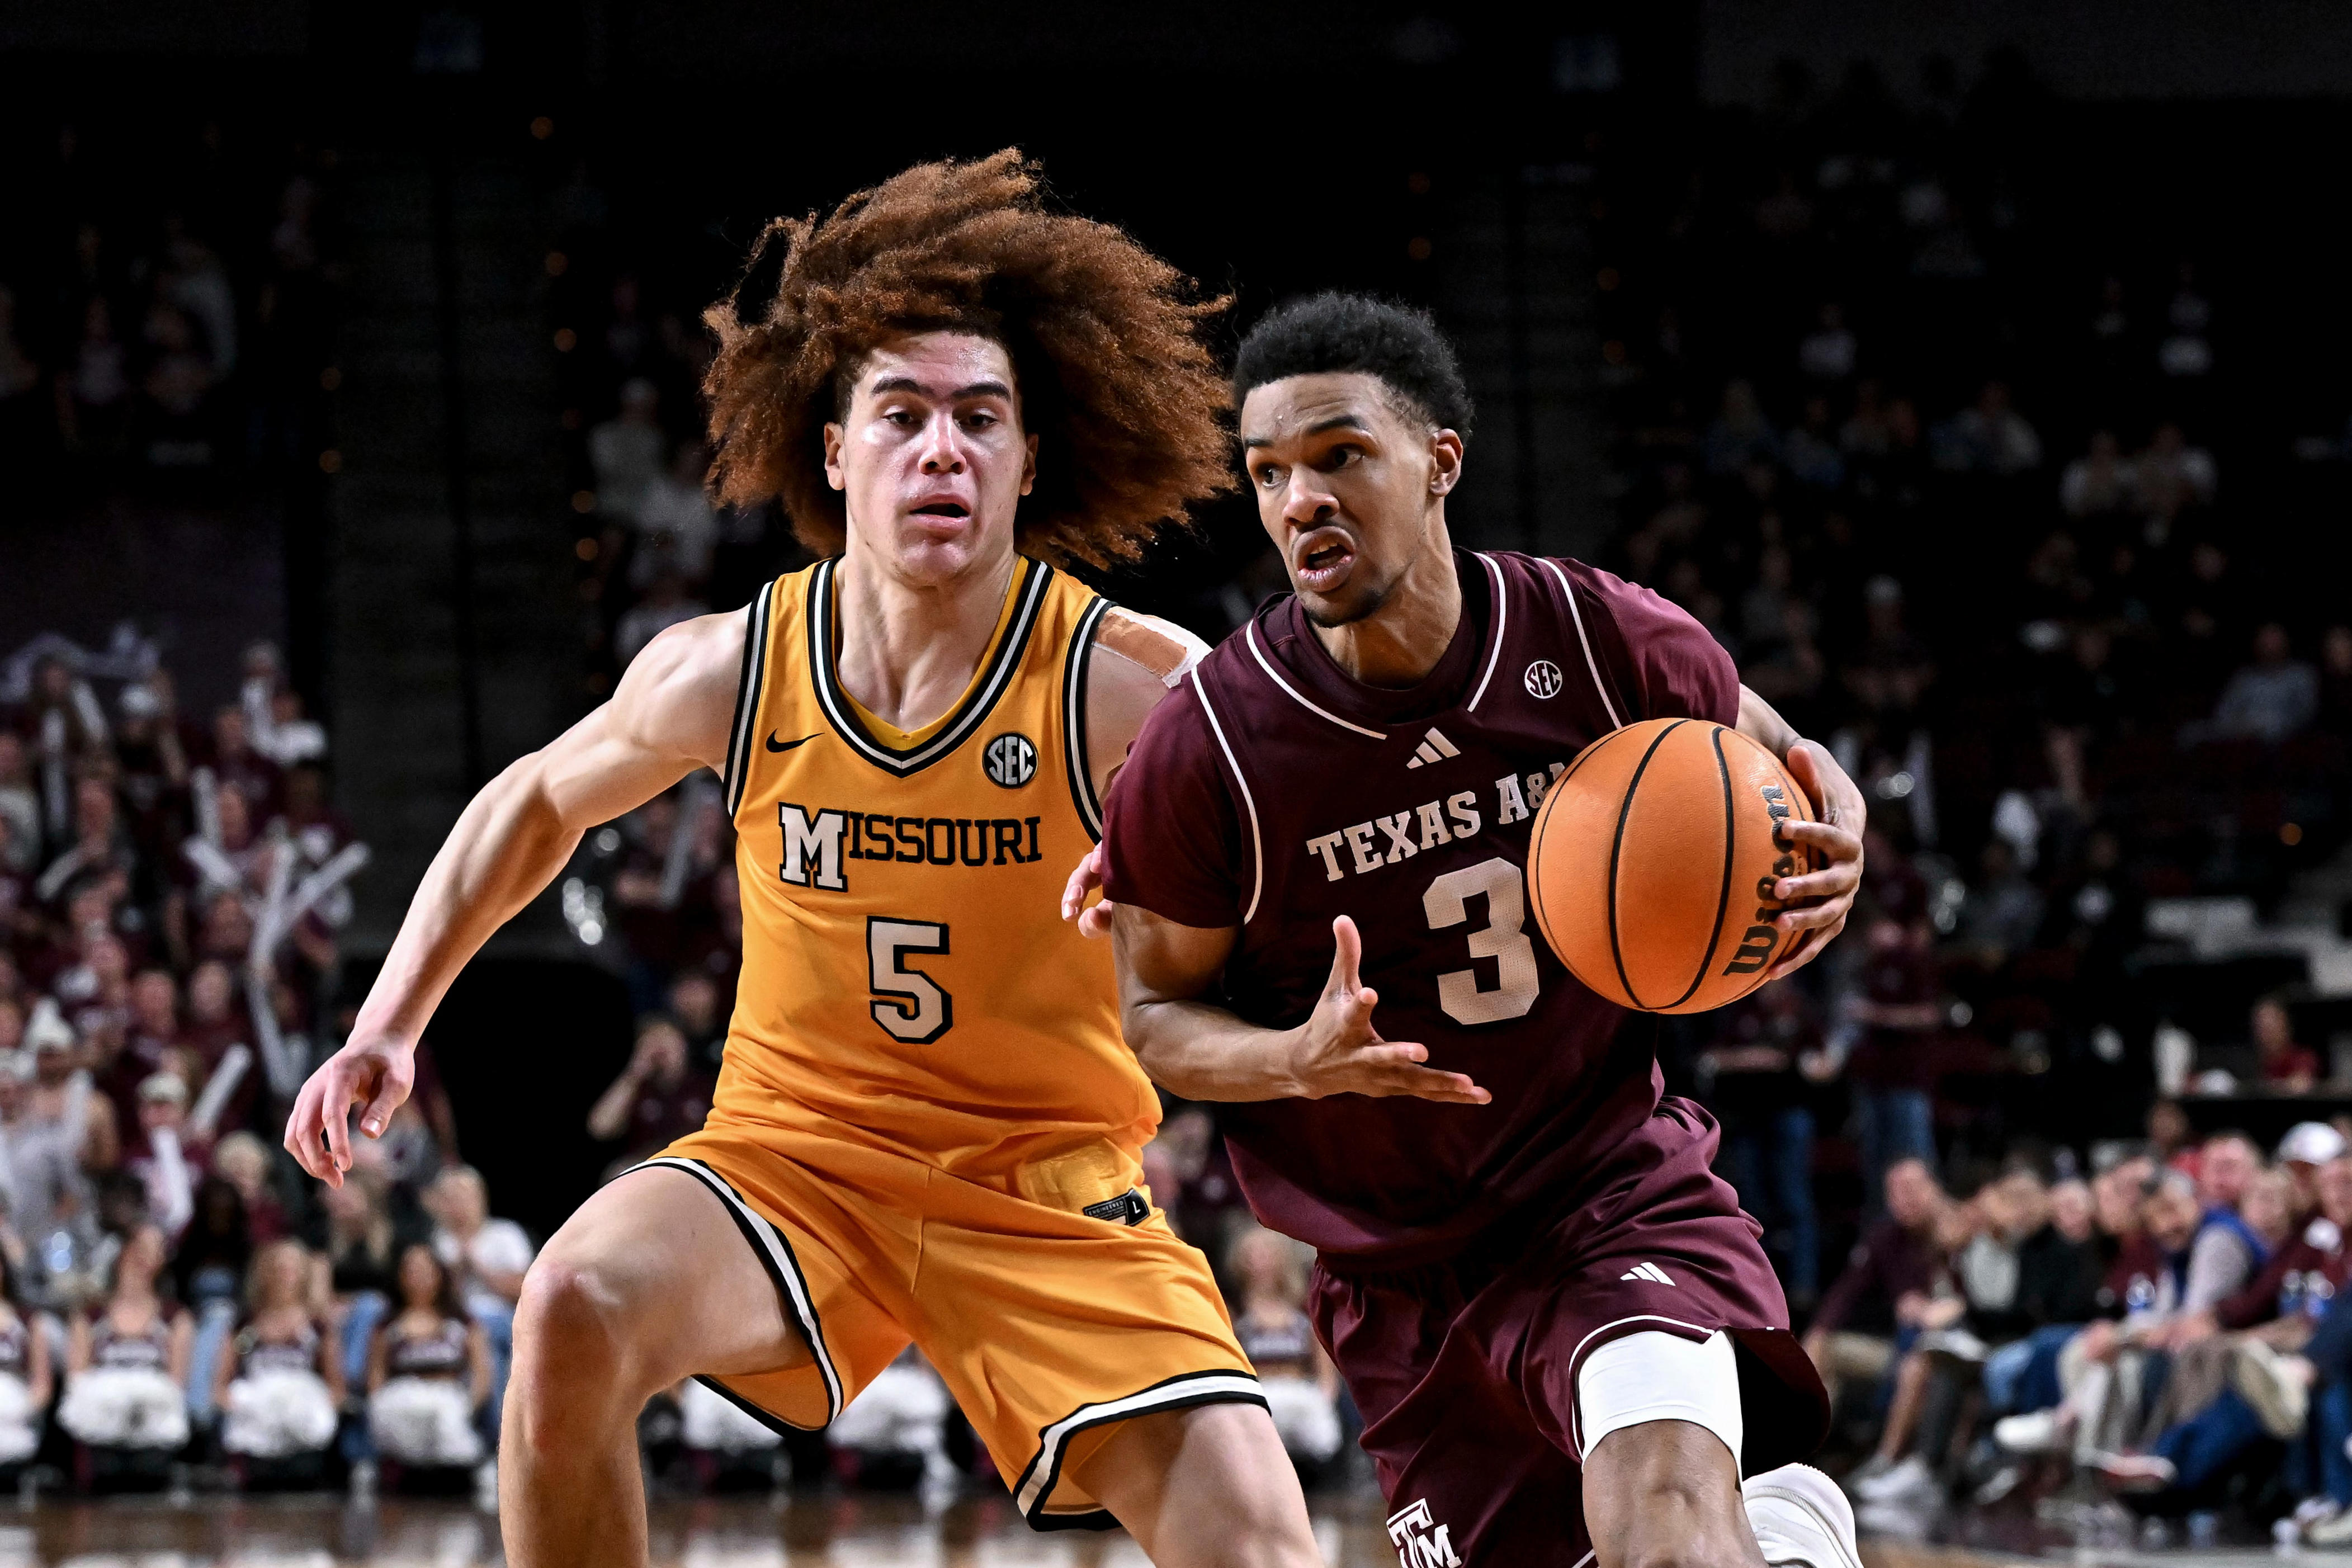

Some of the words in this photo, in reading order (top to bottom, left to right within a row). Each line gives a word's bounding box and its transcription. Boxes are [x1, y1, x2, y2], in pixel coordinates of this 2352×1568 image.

[1526, 662, 1561, 697] SEC
[988, 736, 1034, 785] SEC
[778, 801, 1042, 892] MISSOURI
[1306, 790, 1481, 882] TEXAS
[1495, 762, 1565, 825] A&
[866, 915, 953, 1045] 5
[1422, 857, 1540, 1026] 3
[1132, 1201, 1141, 1214] L
